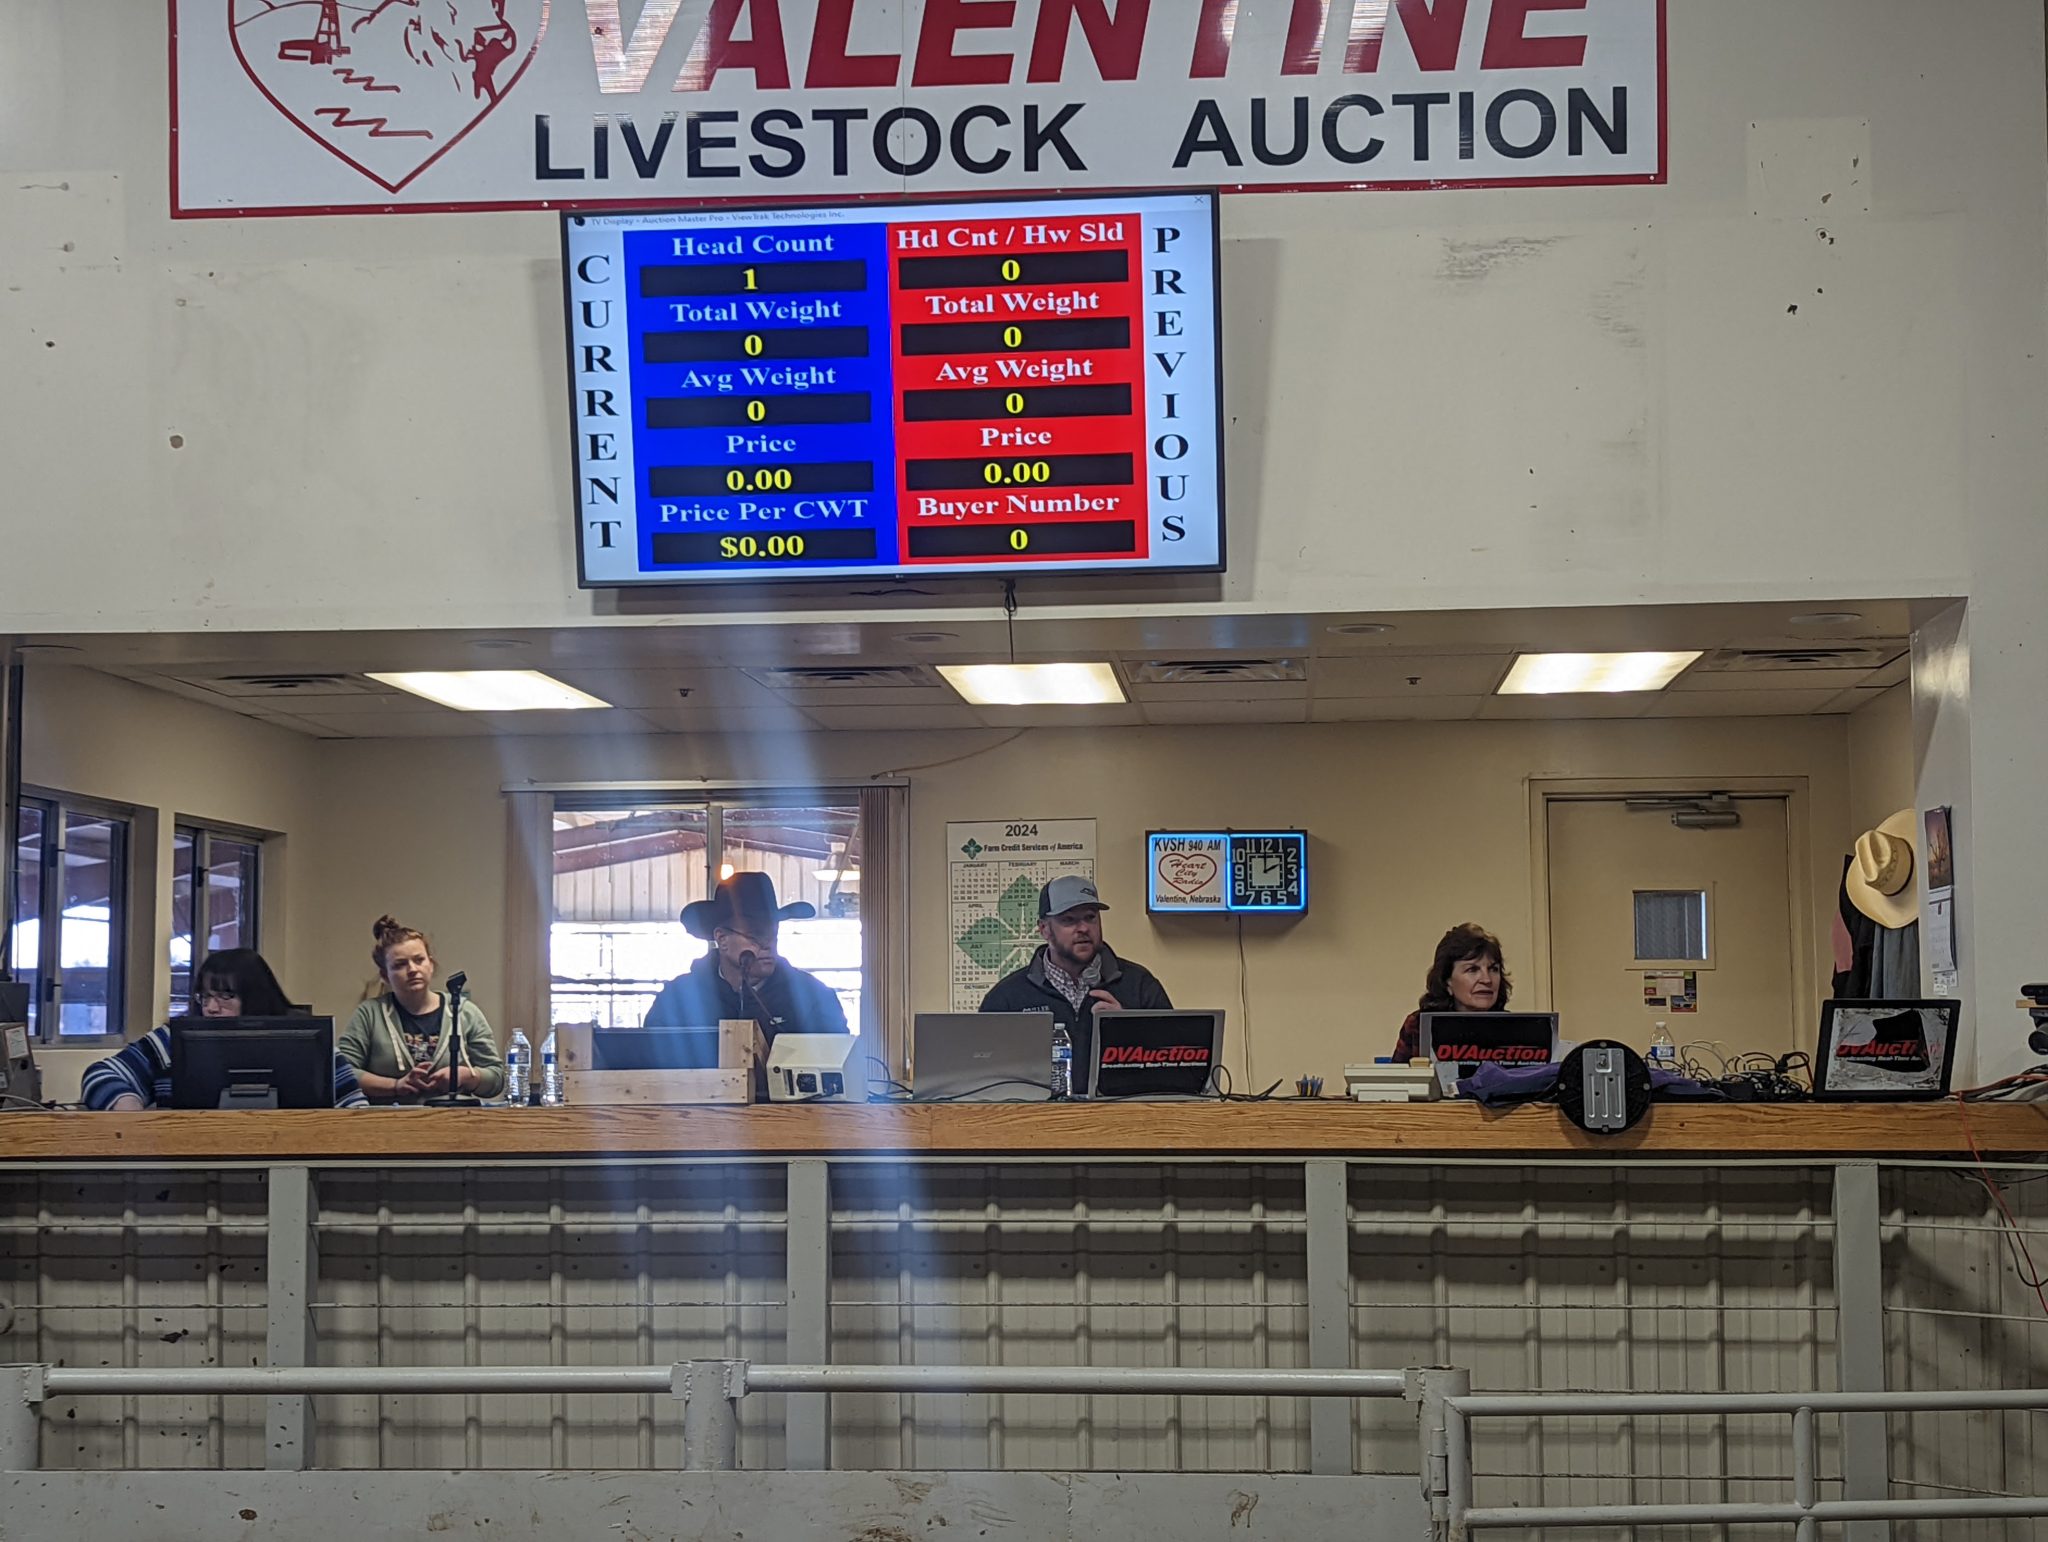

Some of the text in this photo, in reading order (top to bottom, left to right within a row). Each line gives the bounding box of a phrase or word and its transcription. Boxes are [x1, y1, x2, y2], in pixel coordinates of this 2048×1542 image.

[535, 86, 1627, 181] LIVESTOCK AUCTION
[603, 217, 633, 226] Display
[672, 234, 835, 256] Head Count
[897, 222, 1124, 249] Hd Cnt / Hw Sld
[743, 268, 759, 290] 1
[1002, 259, 1021, 281] 0
[670, 300, 842, 324] Total Weight
[925, 291, 1100, 316] Total Weight
[744, 335, 763, 356] 0
[1004, 326, 1023, 348] 0
[681, 366, 837, 392] Avg Weight
[935, 358, 1094, 384] Avg Weight
[1151, 227, 1190, 542] PREVIOUS
[577, 255, 622, 548] CURRENT
[747, 400, 766, 422] 0
[1005, 392, 1024, 414] 0
[726, 435, 797, 454] Price
[980, 427, 1052, 447] Price
[726, 469, 792, 492] 0.00
[984, 461, 1050, 484] 0.00
[659, 499, 868, 523] Price Per CWT
[917, 494, 1120, 520] Buyer Number
[720, 535, 805, 559] $0.00
[1010, 529, 1029, 550] 0
[1005, 824, 1038, 836] 2024
[984, 844, 999, 852] Farm
[1022, 843, 1048, 851] Services
[1050, 843, 1056, 851] of
[1057, 842, 1083, 850] America
[1154, 838, 1221, 851] KVSH 940 AM
[1245, 838, 1283, 853] 11 12 1
[1287, 848, 1297, 862] 2
[1169, 859, 1207, 869] Heart
[1232, 848, 1245, 863] 10
[1172, 877, 1203, 885] Radio
[1175, 868, 1198, 877] City
[1234, 864, 1244, 879] 9
[1287, 864, 1297, 879] 3
[1155, 894, 1221, 904] Valentine, Nebraska
[1235, 881, 1245, 896] 8
[1245, 891, 1287, 905] 7 6 5
[1287, 881, 1298, 896] 4
[1102, 1046, 1209, 1062] DVAuction
[1436, 1044, 1548, 1060] DVAuction
